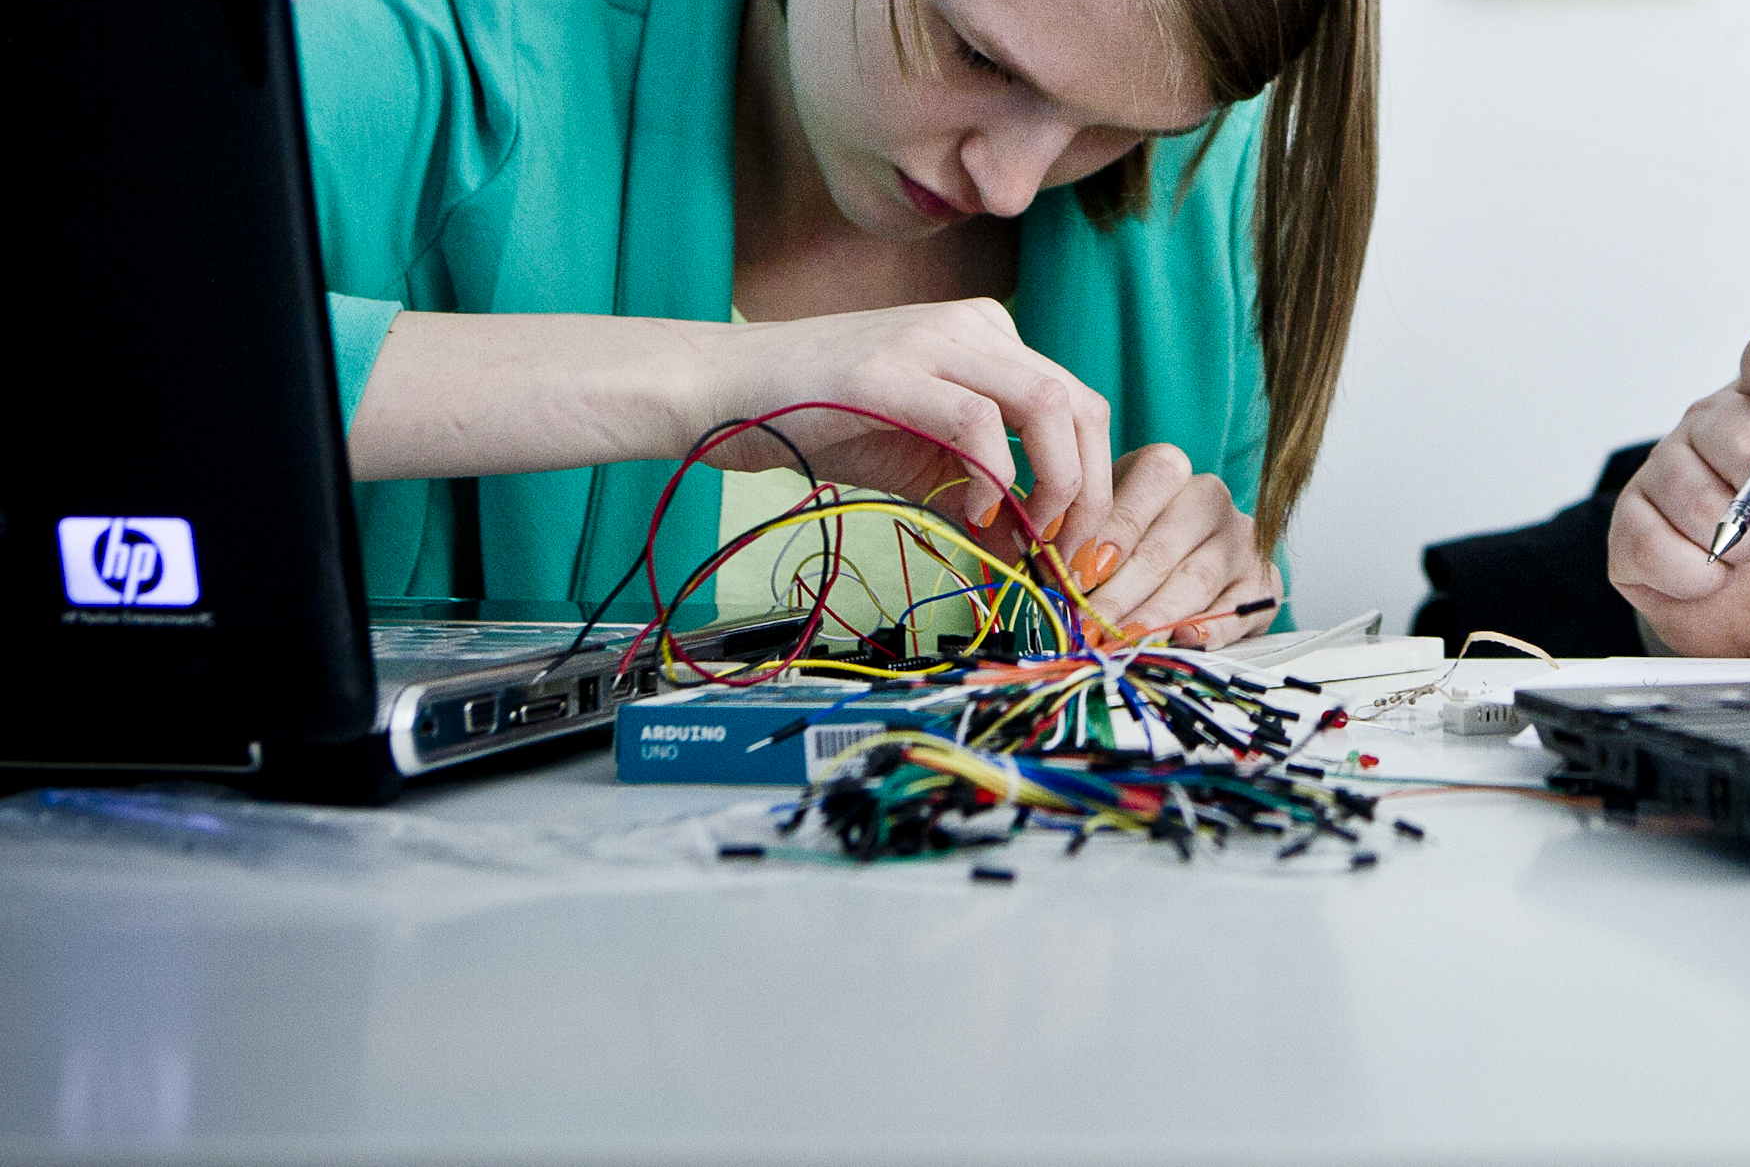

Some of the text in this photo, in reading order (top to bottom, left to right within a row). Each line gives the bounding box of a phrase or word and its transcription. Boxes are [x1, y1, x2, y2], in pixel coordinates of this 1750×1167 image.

[101, 516, 158, 605] hp
[640, 724, 727, 742] ARDUINO
[641, 744, 679, 760] UNO
